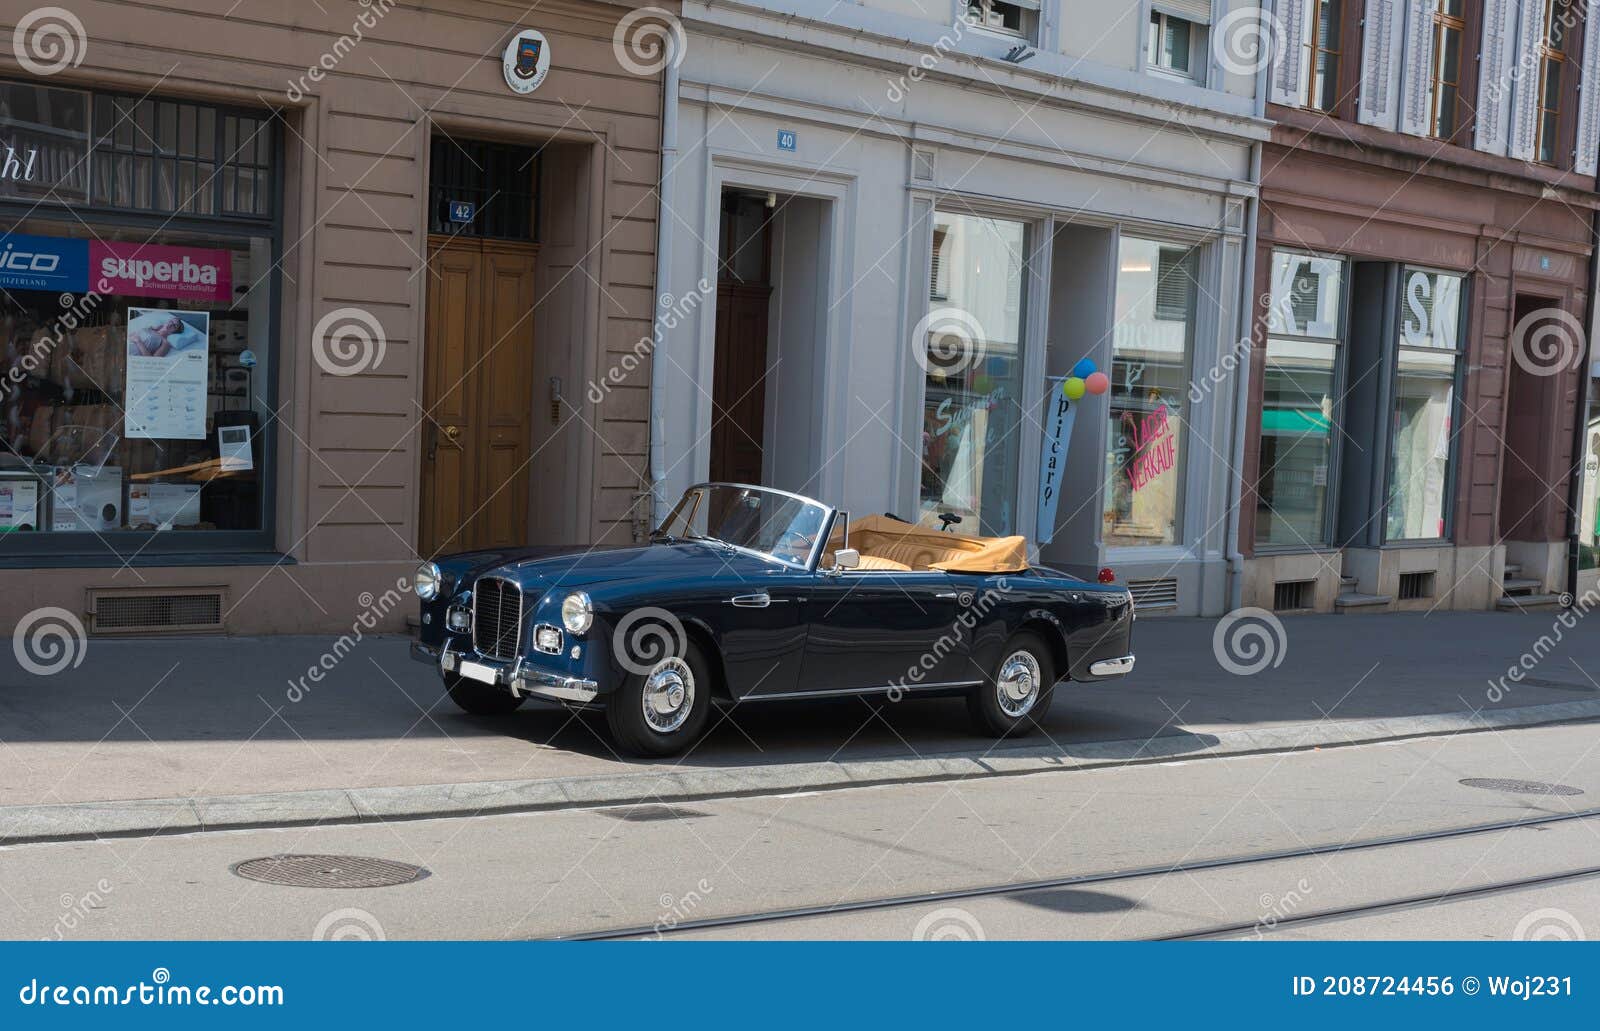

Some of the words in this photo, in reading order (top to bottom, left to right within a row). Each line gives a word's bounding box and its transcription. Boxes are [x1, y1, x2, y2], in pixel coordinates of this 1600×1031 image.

[781, 133, 793, 148] 40
[455, 204, 470, 218] 42
[0, 243, 60, 271] ico
[0, 277, 47, 288] ITZERLAND
[101, 256, 217, 288] superba
[144, 281, 177, 291] Schweizer
[1132, 404, 1170, 451] LAGER
[1044, 393, 1070, 507] picaro
[1126, 434, 1176, 492] VERKAUF
